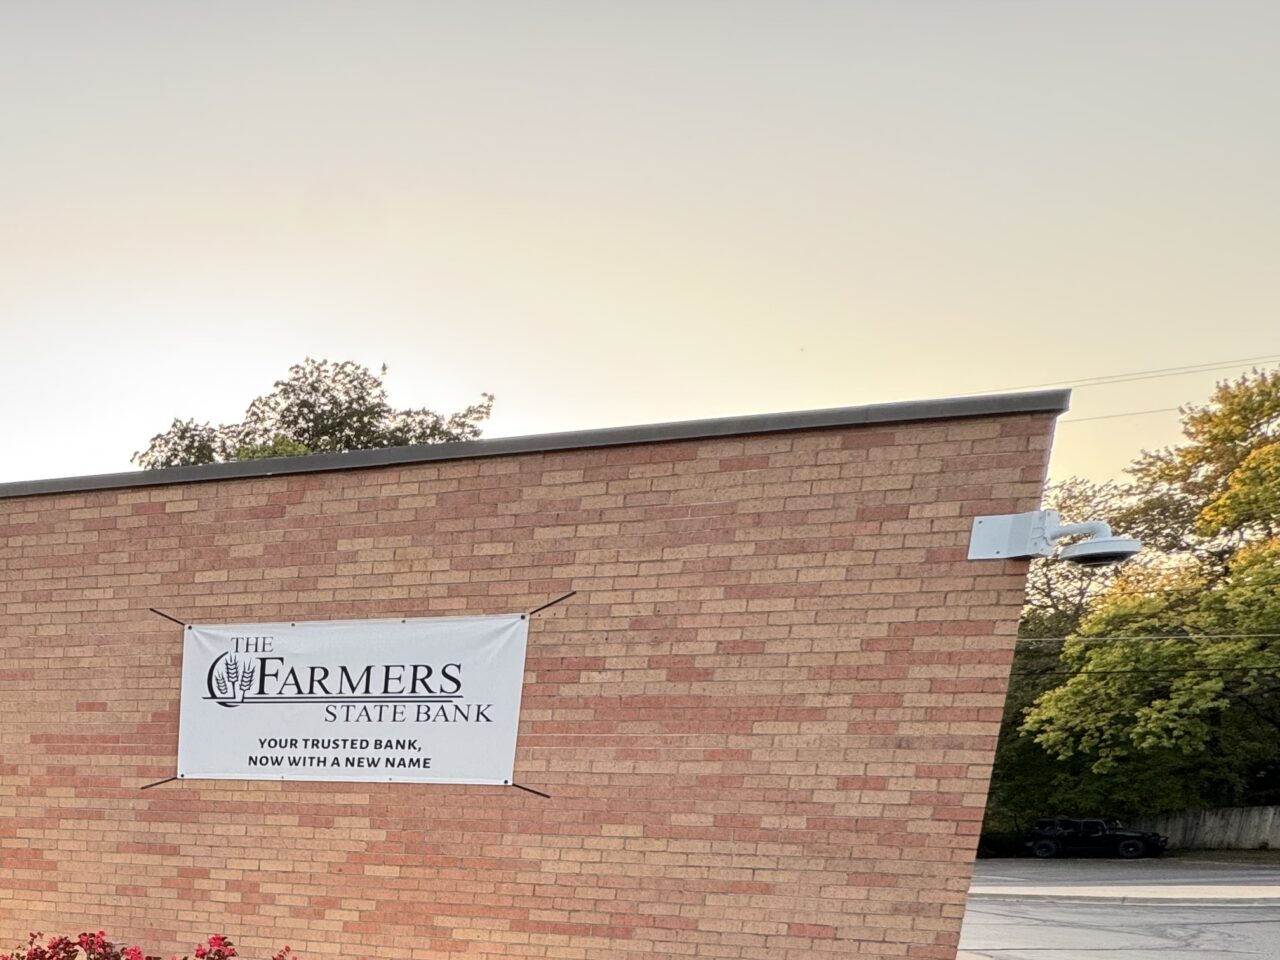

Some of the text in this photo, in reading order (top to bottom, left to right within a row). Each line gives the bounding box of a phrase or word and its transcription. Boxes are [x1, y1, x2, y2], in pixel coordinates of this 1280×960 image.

[231, 636, 274, 653] THE
[324, 704, 494, 723] STATE BANK
[258, 738, 422, 752] YOUR TRUSTED BANK,
[248, 755, 432, 769] NOW WITH A NEW NAME
